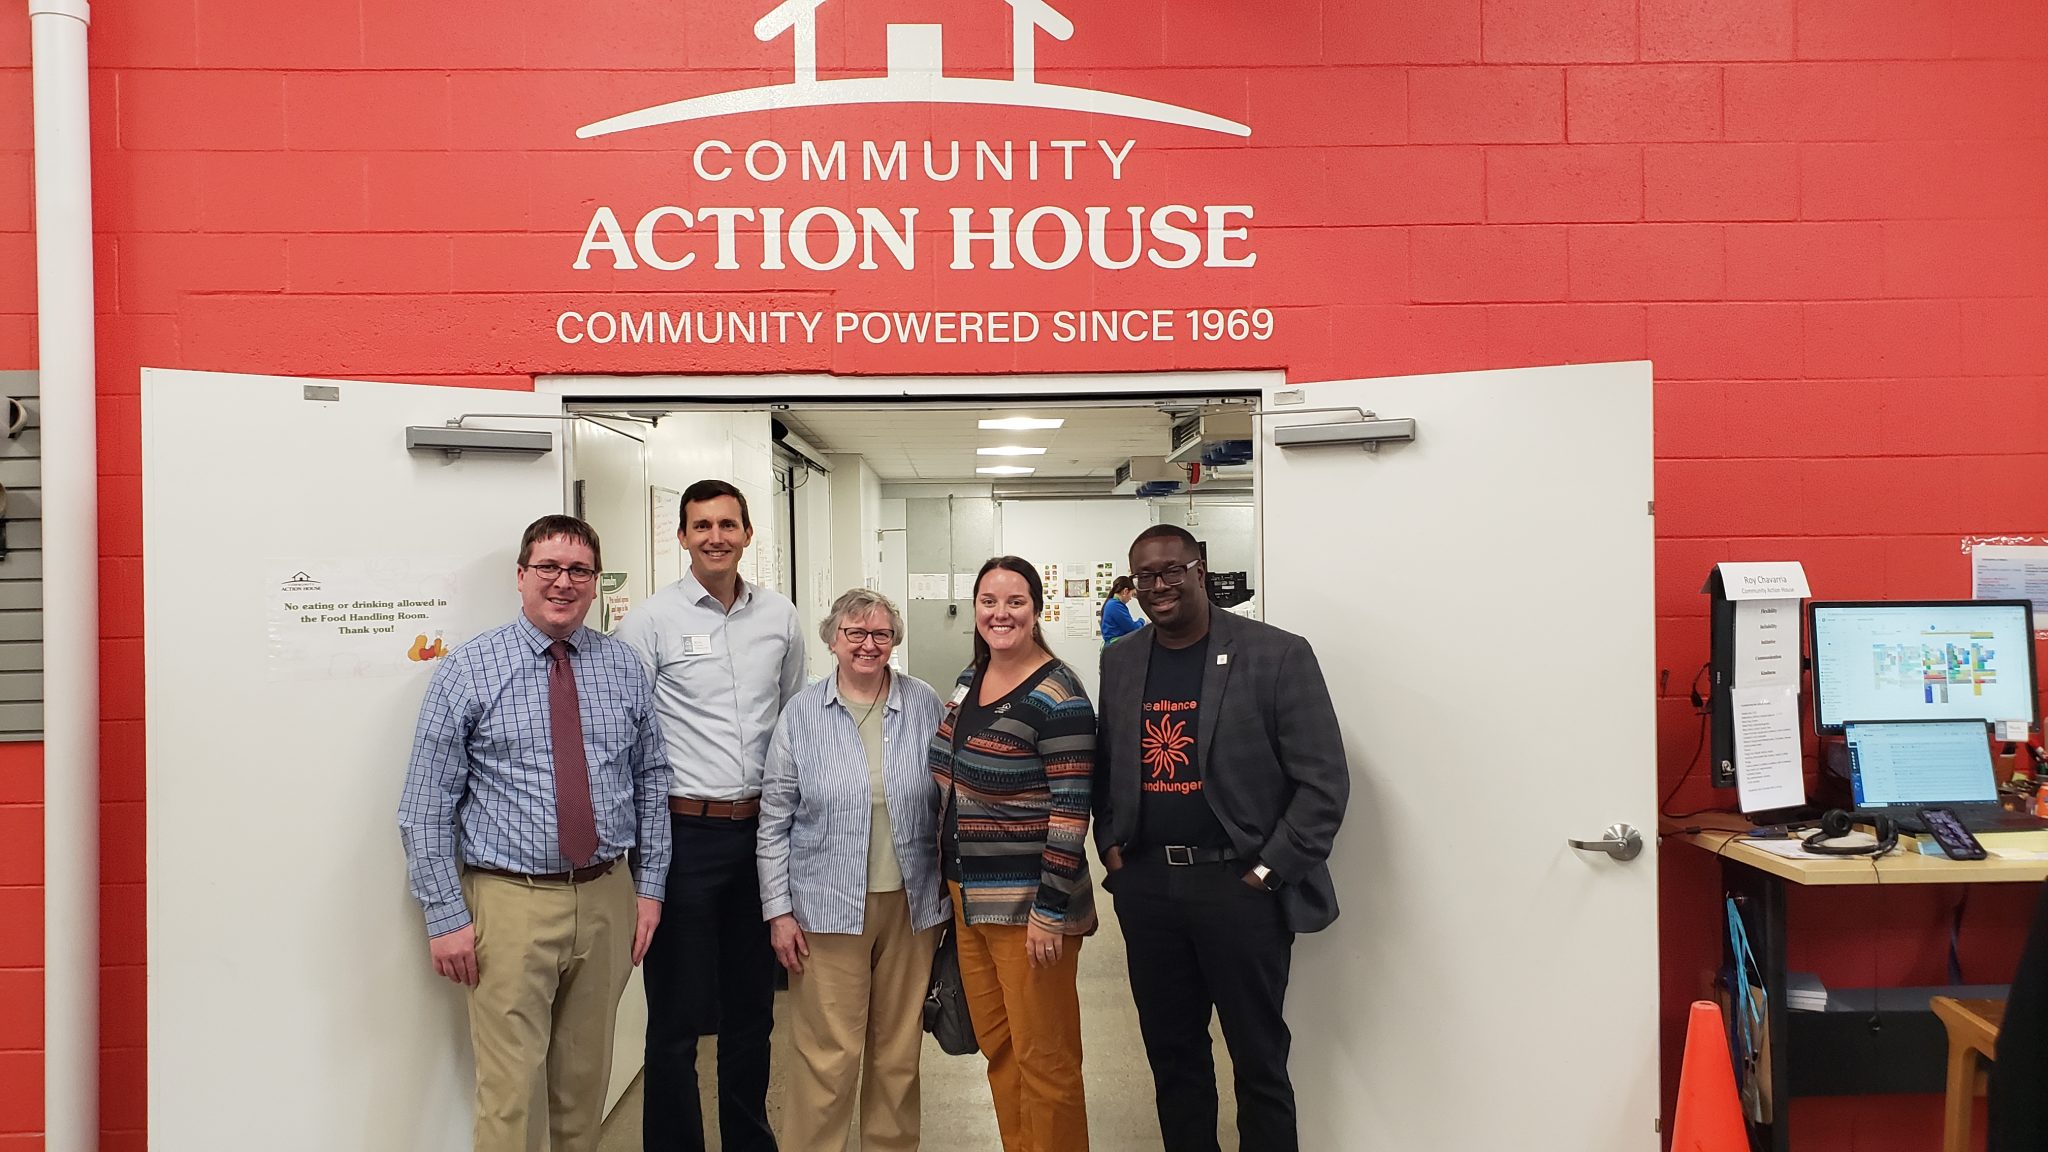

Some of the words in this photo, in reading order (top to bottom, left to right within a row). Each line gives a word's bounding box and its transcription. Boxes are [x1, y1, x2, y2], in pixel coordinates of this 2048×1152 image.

[693, 139, 1136, 182] COMMUNITY
[573, 206, 919, 271] ACTION
[949, 204, 1257, 271] HOUSE
[556, 311, 823, 344] COMMUNITY
[836, 311, 1040, 344] POWERED
[1053, 310, 1174, 343] SINCE
[1187, 309, 1274, 341] 1969
[1744, 576, 1757, 585] Roy
[284, 602, 299, 611] No
[302, 601, 335, 611] eating
[351, 600, 395, 610] drinking
[396, 598, 435, 608] allowed
[437, 598, 448, 607] in
[300, 614, 318, 623] the
[320, 613, 347, 623] Food
[349, 612, 395, 622] Handling
[397, 610, 430, 620] Room.
[338, 626, 370, 634] Thank
[372, 624, 395, 635] you!
